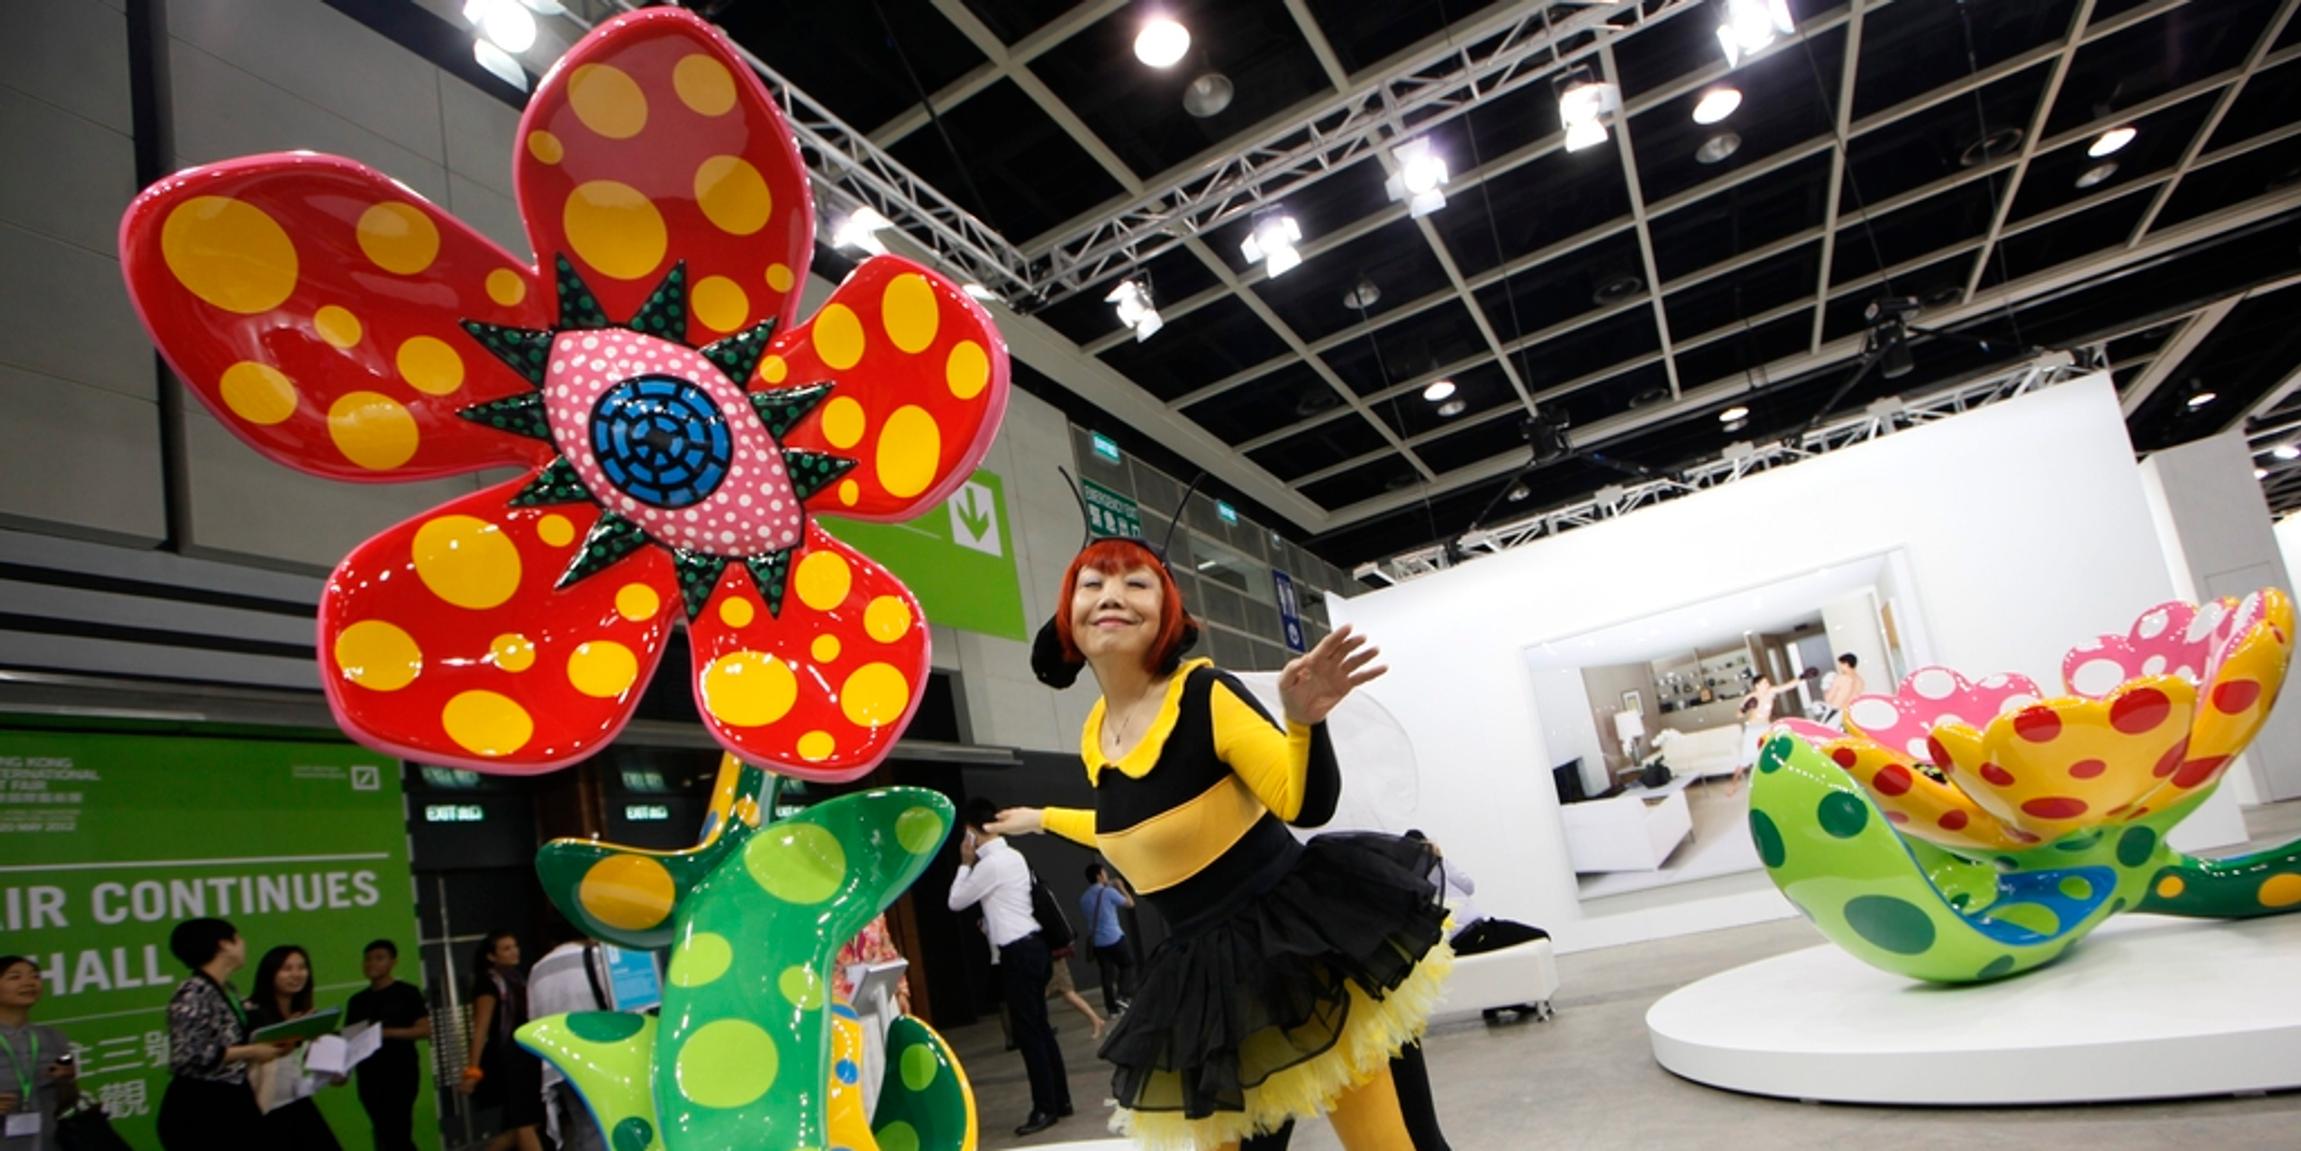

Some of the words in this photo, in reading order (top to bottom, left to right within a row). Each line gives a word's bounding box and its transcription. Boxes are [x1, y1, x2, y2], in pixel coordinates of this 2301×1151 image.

[0, 885, 69, 931] IR
[91, 870, 380, 925] CONTINUES
[25, 944, 173, 996] HALL
